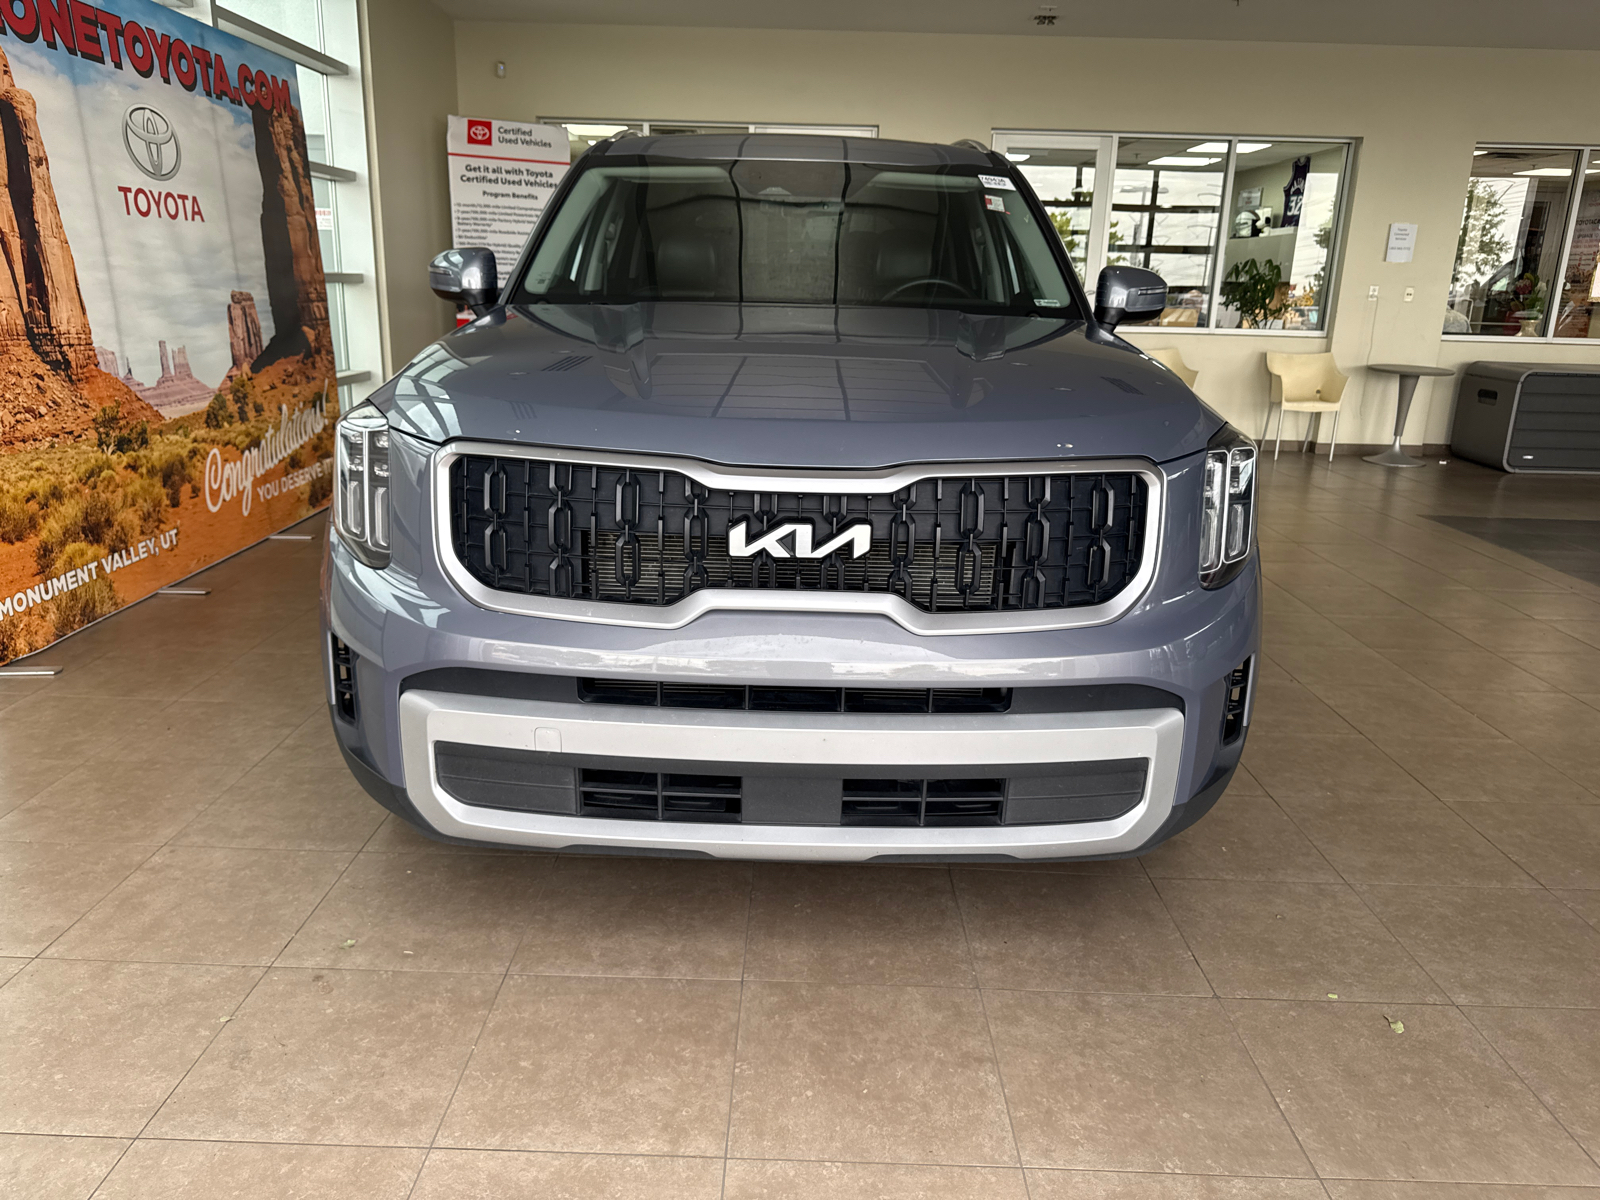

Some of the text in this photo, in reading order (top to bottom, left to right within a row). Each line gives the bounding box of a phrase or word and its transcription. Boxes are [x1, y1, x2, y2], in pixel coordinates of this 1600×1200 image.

[0, 0, 294, 118] ONETOYOTA.COM
[498, 126, 532, 137] Certified
[498, 136, 552, 148] Used Vehicles
[460, 174, 499, 185] Certified
[500, 177, 522, 187] Used
[465, 164, 553, 179] Get it all with Toyota
[117, 186, 205, 223] TOYOTA
[482, 190, 538, 201] Program Benefits
[205, 378, 329, 517] Congratulations!
[256, 480, 279, 502] YOU
[281, 463, 323, 493] DESERVE
[729, 520, 872, 559] KIA
[0, 528, 179, 621] MONUMENT VALLEY, UT
